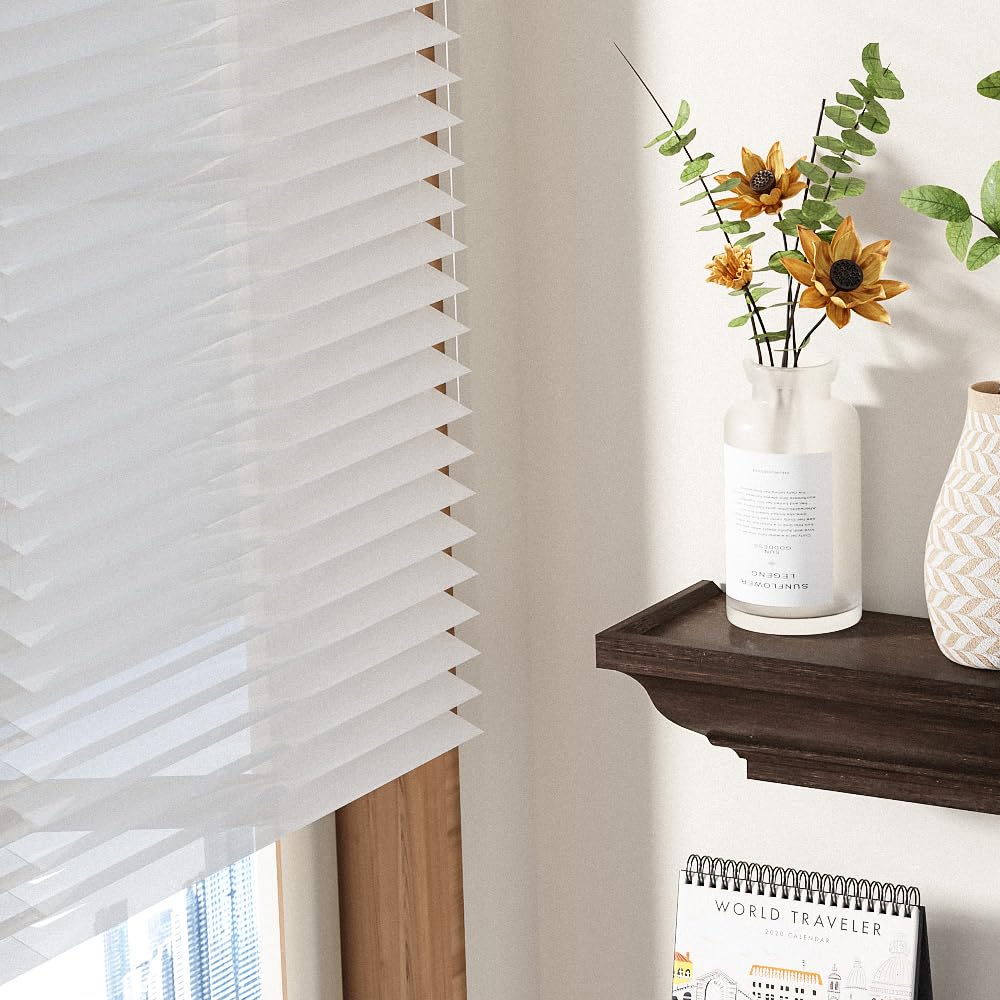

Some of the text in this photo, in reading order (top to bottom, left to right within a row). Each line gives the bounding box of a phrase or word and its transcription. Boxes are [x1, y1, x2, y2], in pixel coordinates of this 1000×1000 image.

[741, 579, 809, 590] SUNFLOWER
[714, 899, 881, 936] WORLD TRAVELER
[764, 928, 830, 943] 2020 CALENDAR
